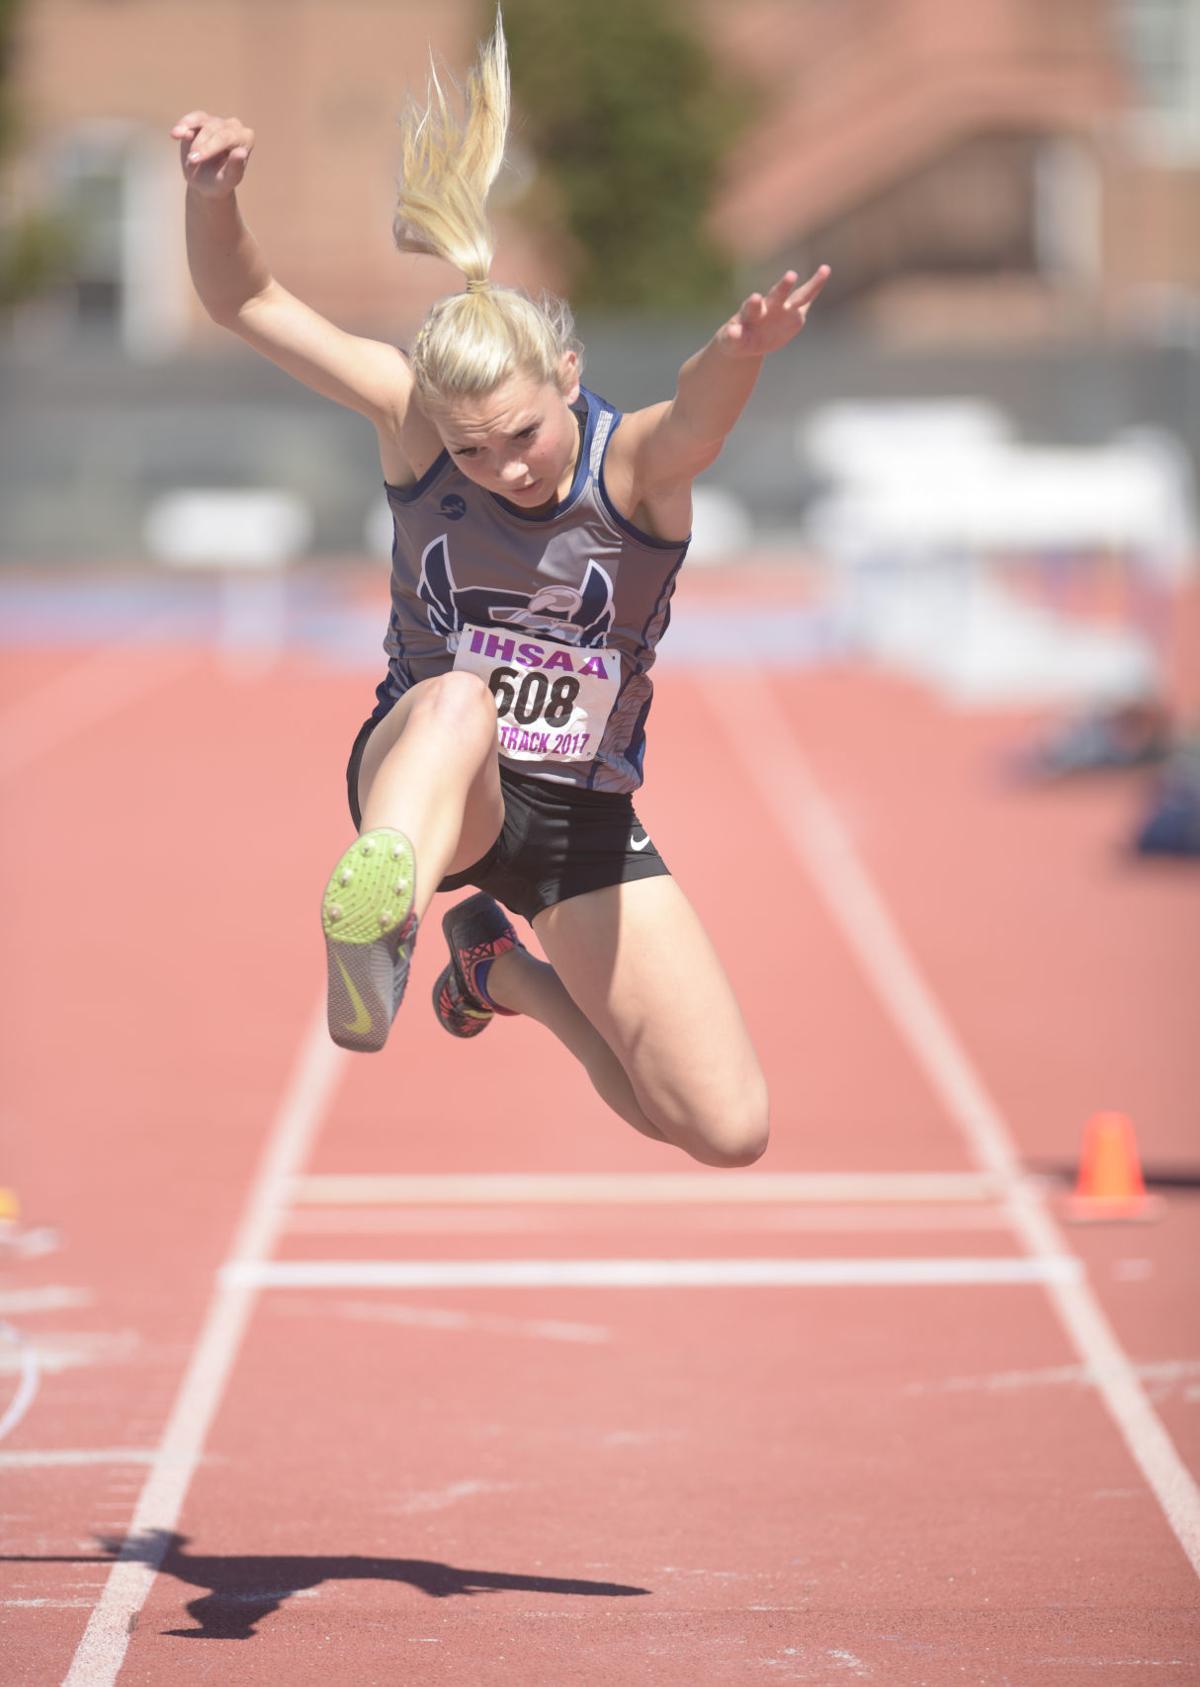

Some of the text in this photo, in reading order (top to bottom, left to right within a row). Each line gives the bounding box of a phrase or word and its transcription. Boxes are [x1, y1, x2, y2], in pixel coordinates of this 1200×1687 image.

[470, 630, 608, 680] IHSAA
[488, 666, 580, 728] 608
[500, 726, 590, 754] TRACK 2017
